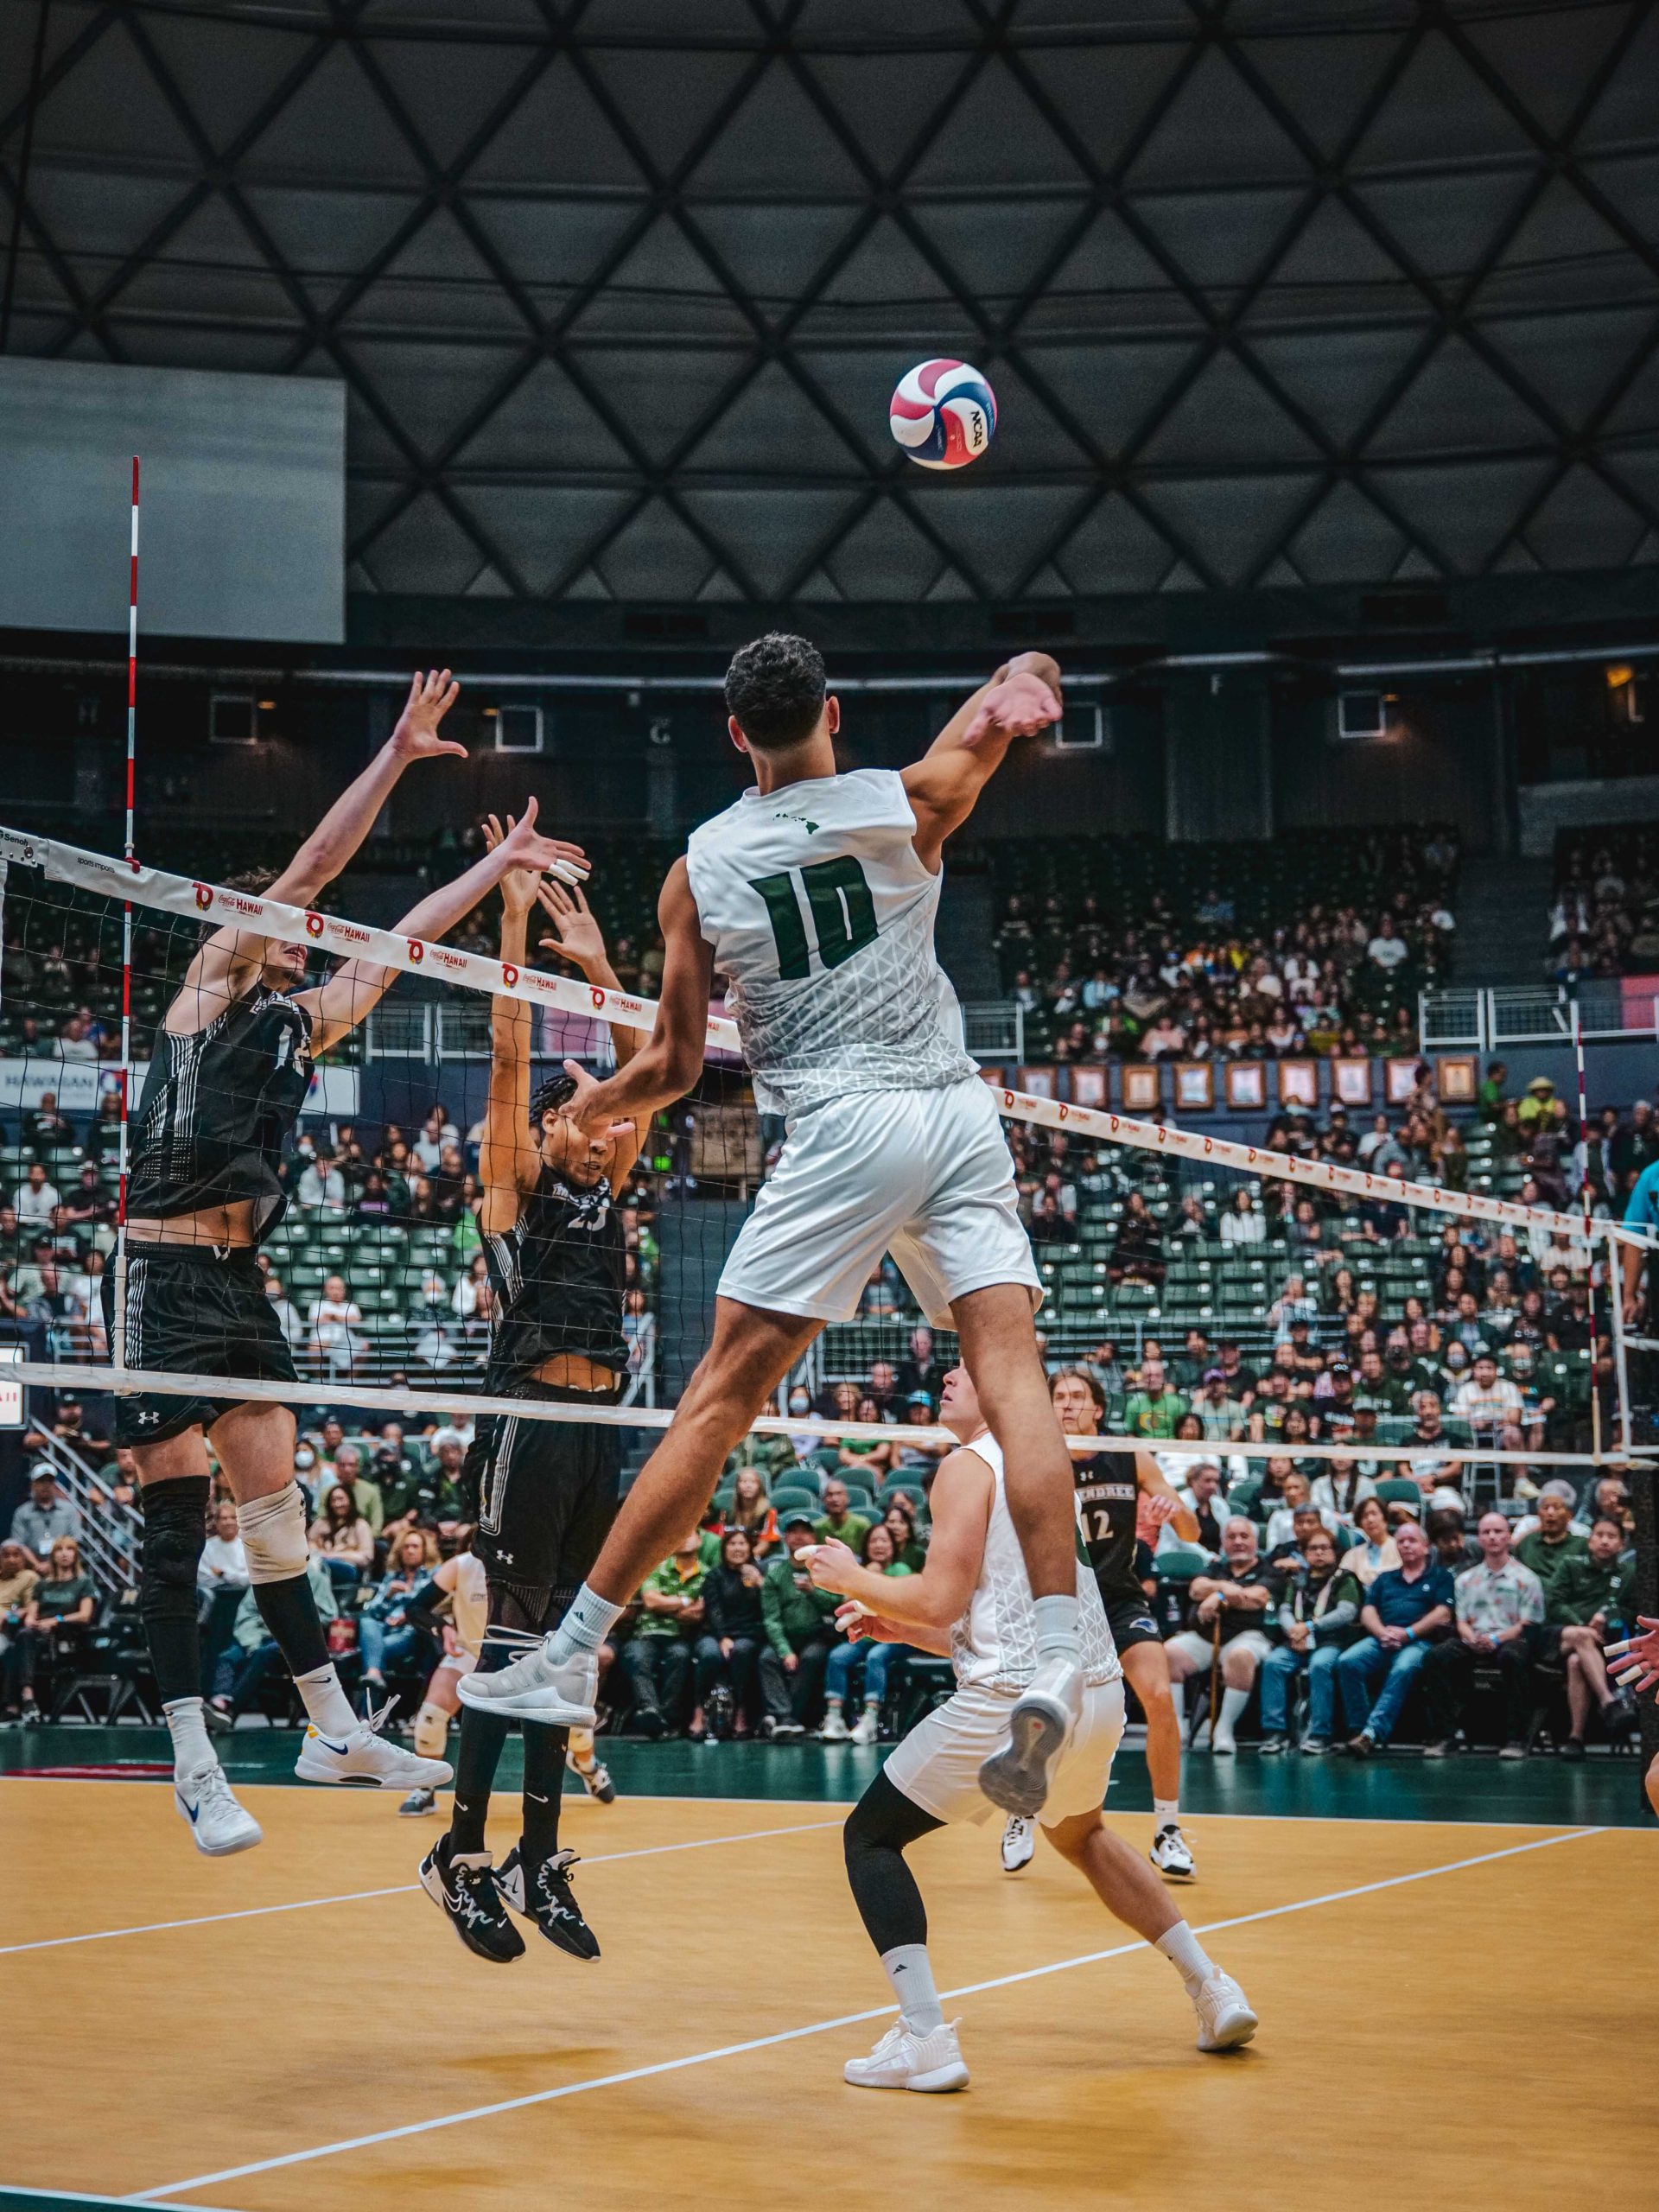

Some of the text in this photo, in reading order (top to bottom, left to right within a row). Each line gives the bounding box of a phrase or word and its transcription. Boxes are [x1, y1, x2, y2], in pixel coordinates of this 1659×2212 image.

[971, 410, 982, 448] NCAA
[4, 833, 29, 847] Senoh
[77, 856, 94, 867] sports
[236, 898, 264, 916] HAWAII
[747, 855, 880, 981] 10
[344, 925, 371, 943] HAWAII
[443, 952, 467, 968] HAWAII
[537, 976, 557, 991] HAWAII
[620, 999, 643, 1013] HAWAII
[1081, 1510, 1114, 1542] 12
